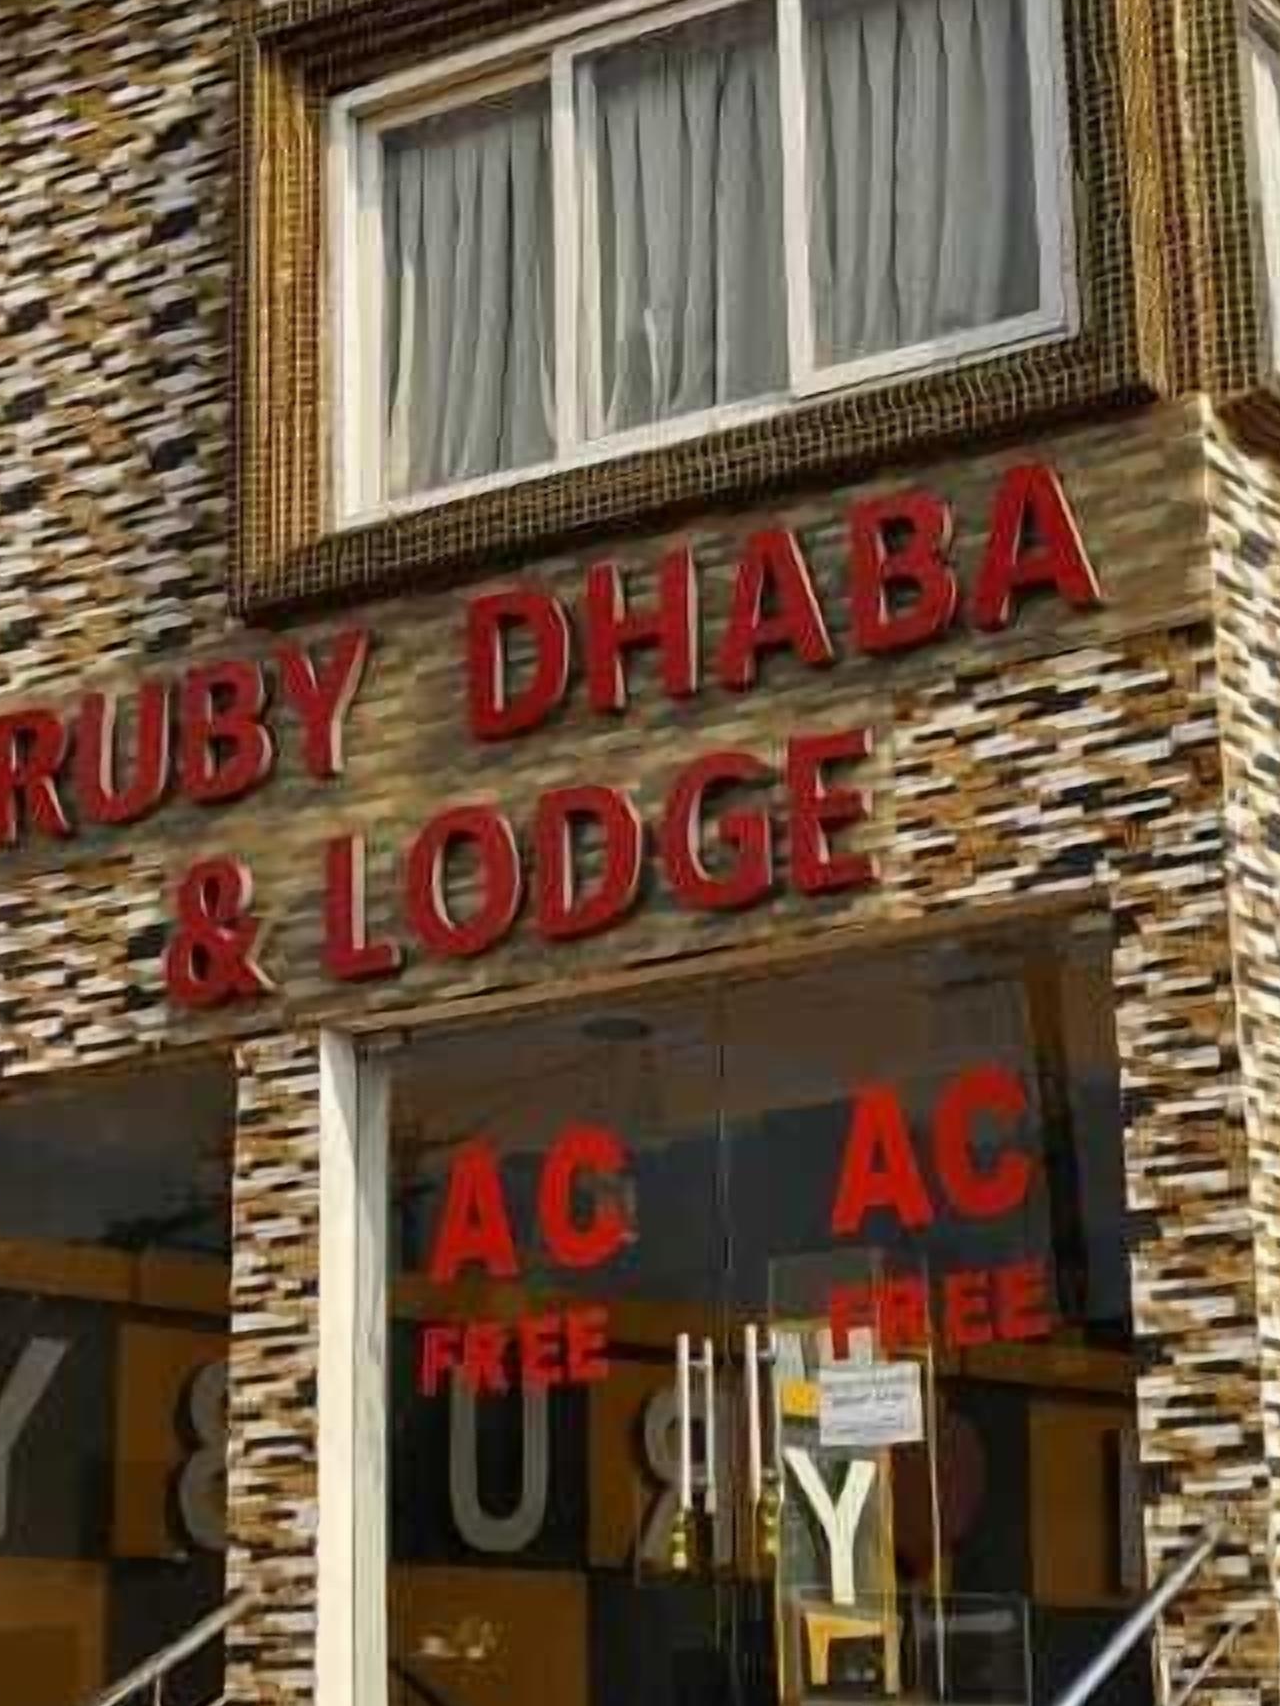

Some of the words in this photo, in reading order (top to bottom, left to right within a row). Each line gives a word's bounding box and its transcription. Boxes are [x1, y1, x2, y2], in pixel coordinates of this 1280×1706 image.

[464, 459, 1104, 743] DHABA
[163, 856, 278, 1007] &
[322, 727, 877, 982] LODGE
[427, 1120, 635, 1289] AC
[830, 1061, 1032, 1237] AC
[417, 1303, 612, 1396] FREE
[826, 1258, 1053, 1362] FREE
